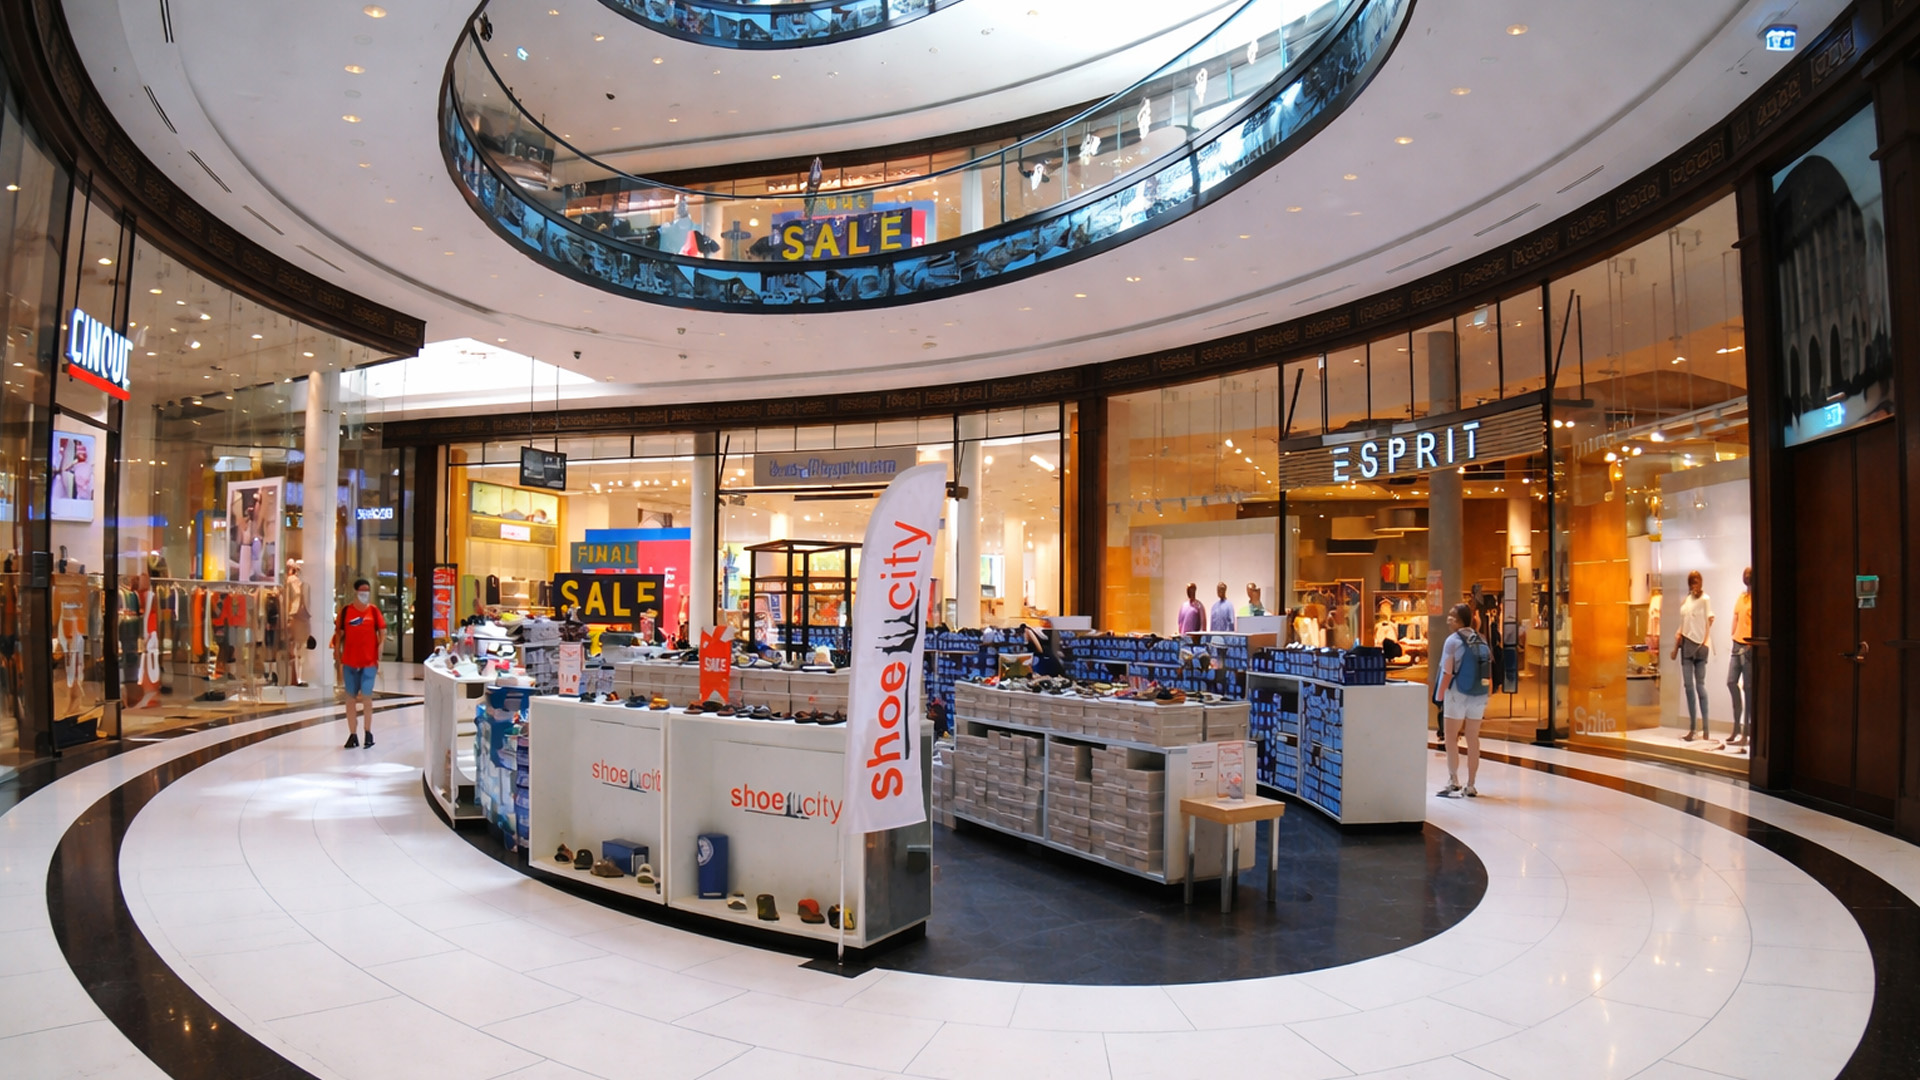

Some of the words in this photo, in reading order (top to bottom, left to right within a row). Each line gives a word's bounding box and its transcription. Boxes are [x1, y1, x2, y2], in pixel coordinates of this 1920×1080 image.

[782, 215, 903, 261] SALE
[1332, 421, 1480, 482] ESPRIT
[577, 544, 634, 564] FINAL
[880, 520, 932, 610] city
[561, 579, 656, 617] SALE
[866, 660, 906, 801] shoe
[591, 761, 629, 785] shoe
[730, 784, 786, 811] shoe
[803, 791, 843, 825] city
